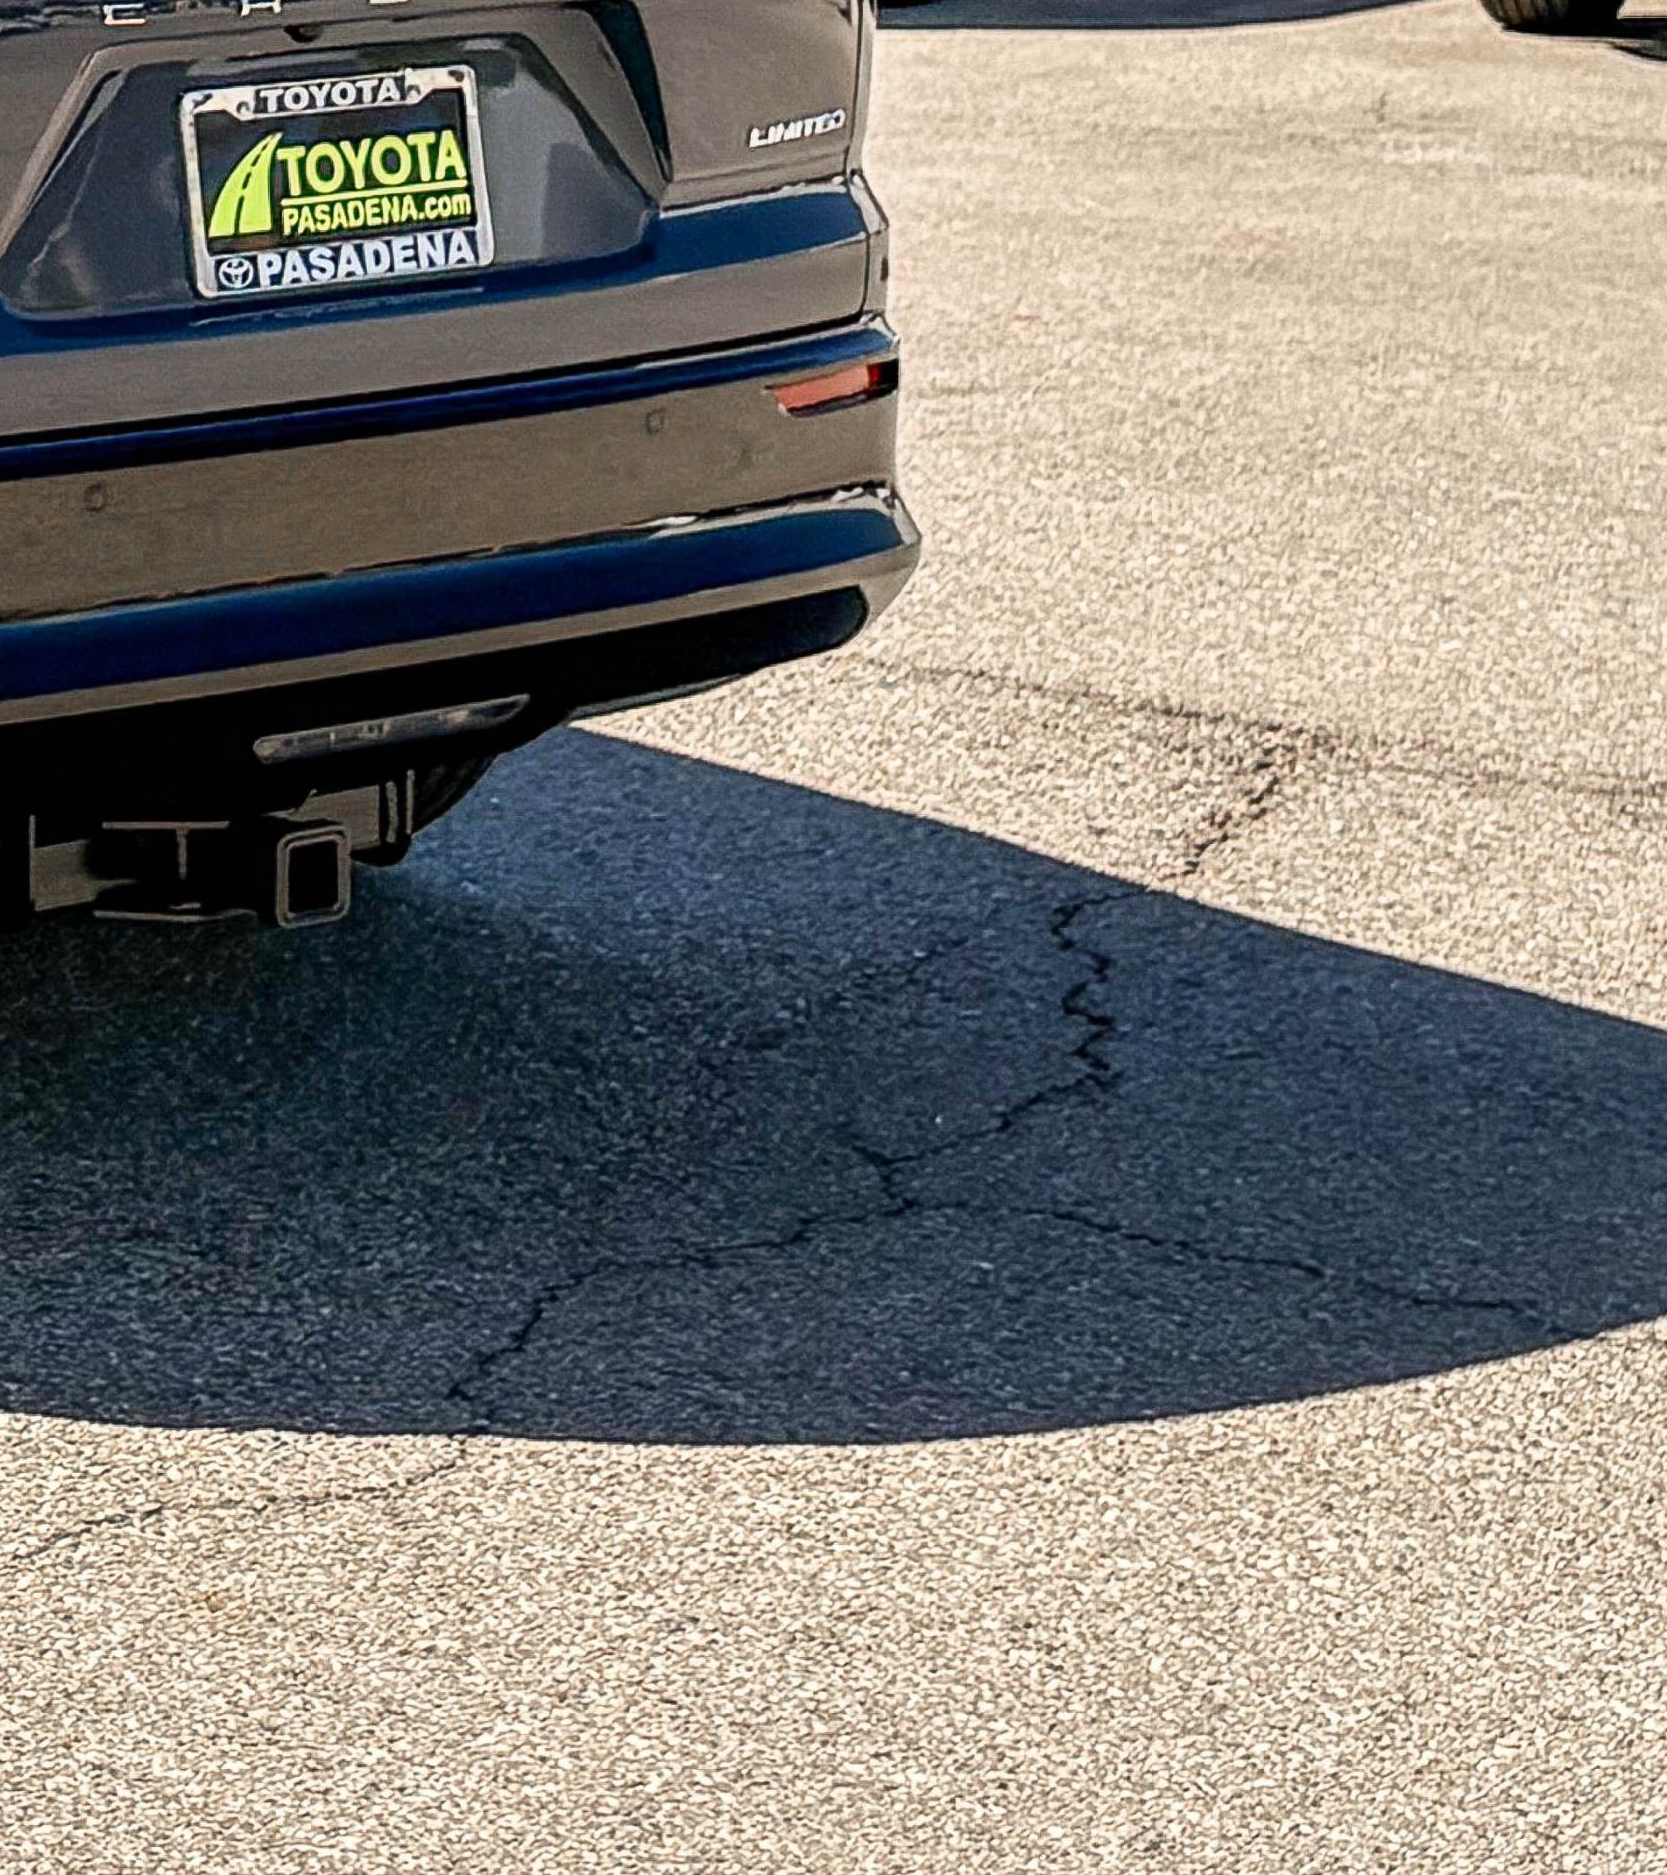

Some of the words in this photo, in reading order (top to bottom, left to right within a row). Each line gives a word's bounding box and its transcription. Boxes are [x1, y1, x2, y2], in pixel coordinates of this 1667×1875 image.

[260, 77, 402, 113] TOYOTA
[748, 108, 846, 148] LIMITED
[276, 129, 468, 197] TOYOTA
[282, 193, 472, 238] PASADENA.com
[257, 231, 479, 288] PASADENA
